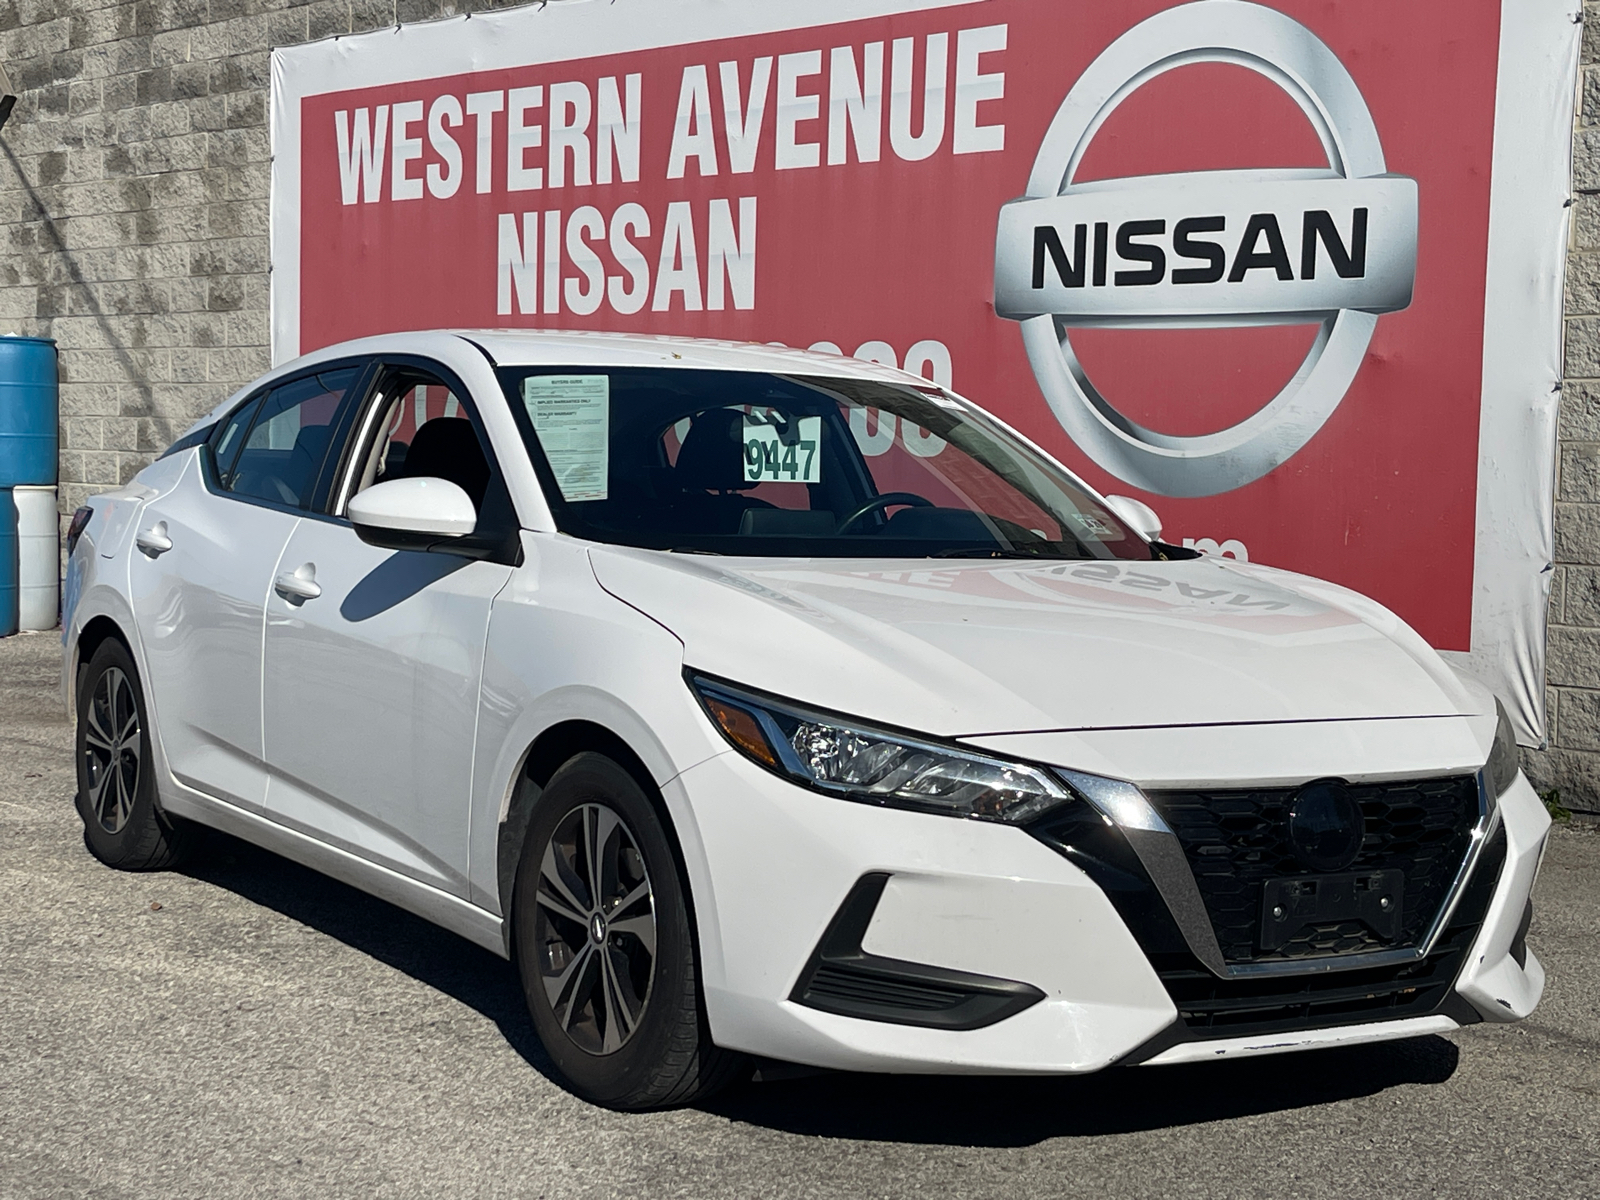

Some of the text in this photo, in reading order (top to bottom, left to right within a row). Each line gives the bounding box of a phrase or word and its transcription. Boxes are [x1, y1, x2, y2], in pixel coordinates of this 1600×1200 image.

[335, 24, 1009, 206] WESTERN AVENUE
[497, 196, 758, 316] NISSAN
[1032, 207, 1369, 290] NISSAN
[747, 439, 816, 480] 9447
